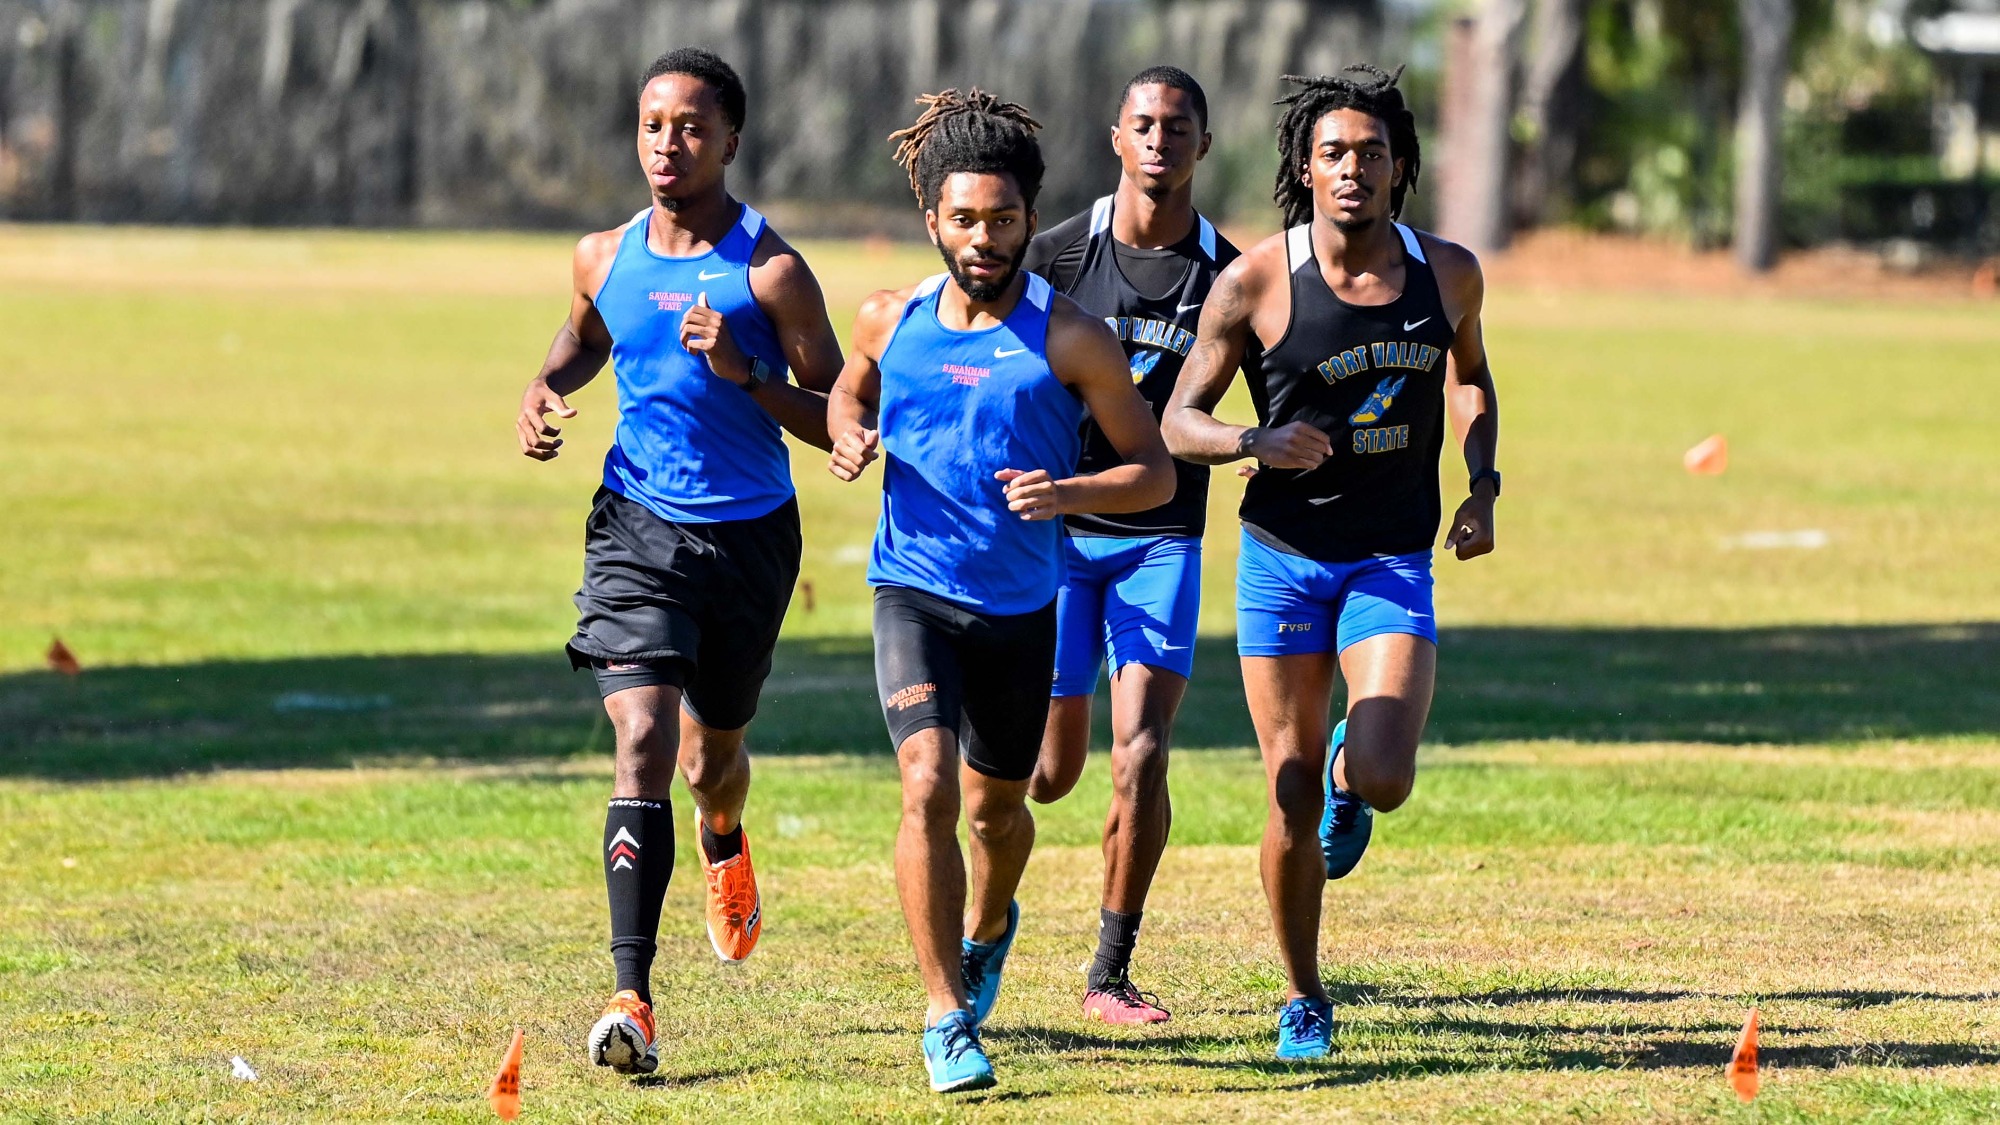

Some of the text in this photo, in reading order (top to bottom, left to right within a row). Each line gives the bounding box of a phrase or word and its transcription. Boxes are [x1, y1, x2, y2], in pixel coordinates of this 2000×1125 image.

[648, 291, 693, 302] SAVANNAH
[658, 301, 682, 311] STATE
[1132, 316, 1198, 357] VALLEY
[942, 363, 990, 378] SAVANNAH
[1317, 341, 1441, 385] FORT VALLEY
[952, 374, 980, 387] STATE
[1353, 424, 1409, 454] STATE
[1278, 622, 1312, 633] FVSU
[886, 682, 937, 708] SAVANNAH
[897, 692, 929, 711] STATE
